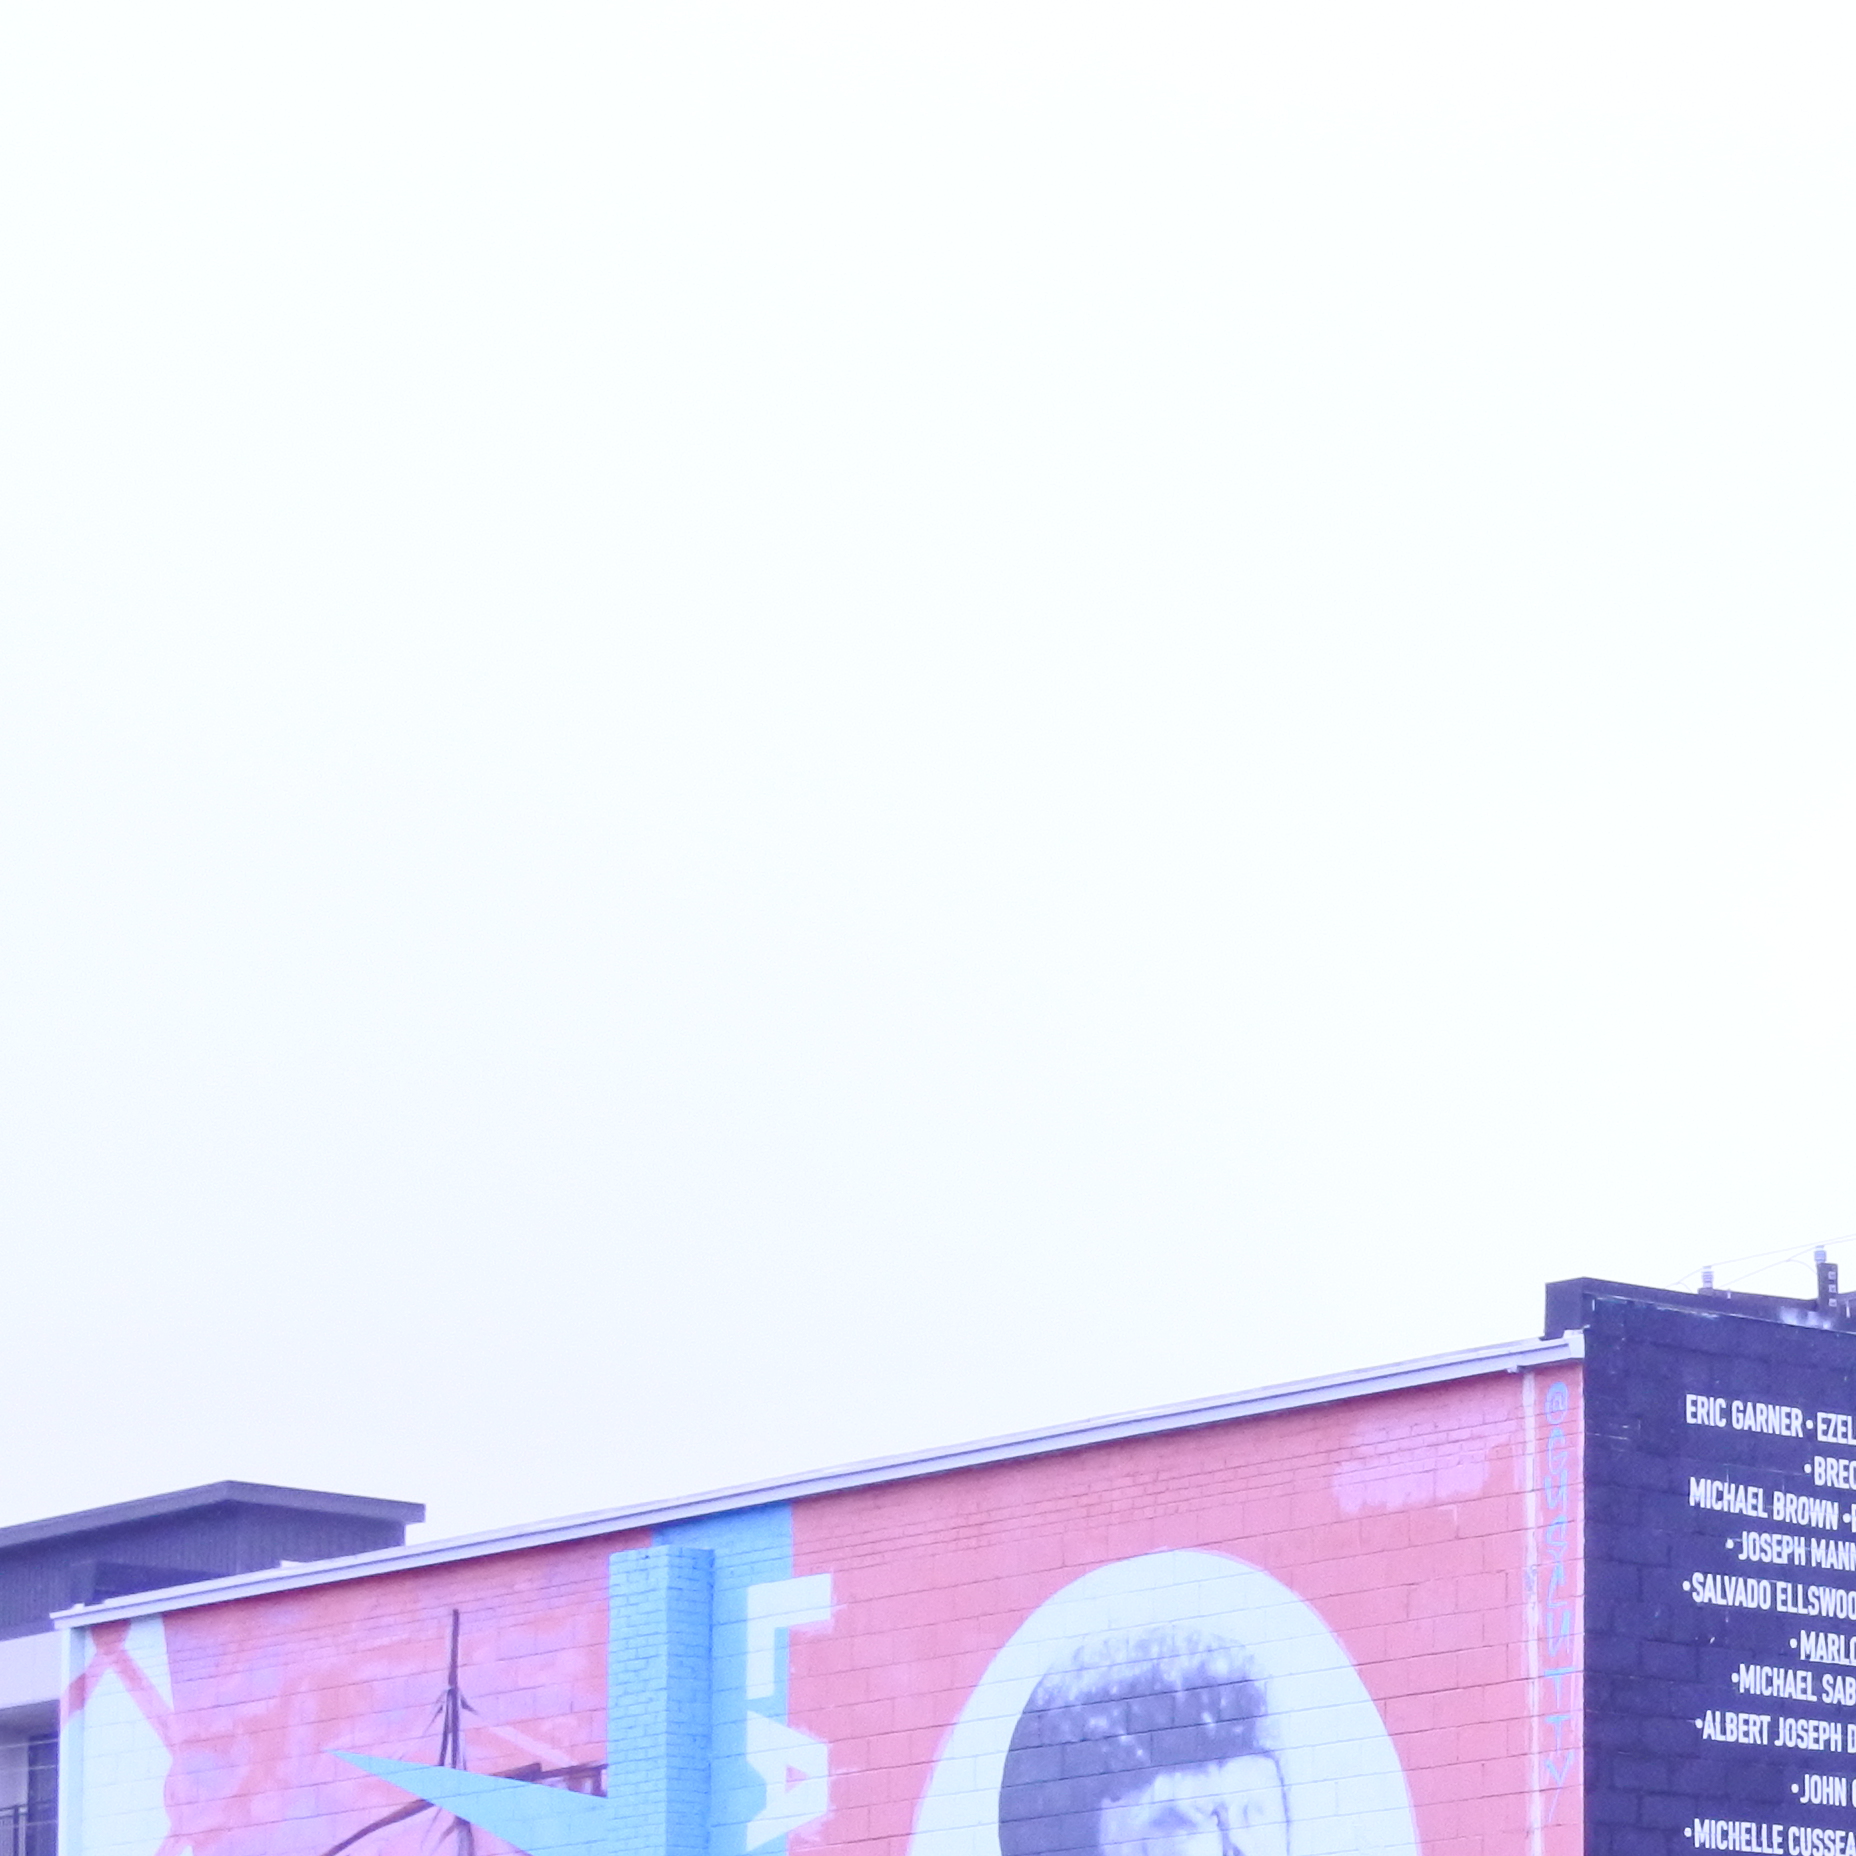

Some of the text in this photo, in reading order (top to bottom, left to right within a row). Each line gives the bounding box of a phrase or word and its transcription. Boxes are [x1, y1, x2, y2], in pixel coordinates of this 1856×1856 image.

[1686, 1394, 1726, 1427] ERIC
[1732, 1400, 1803, 1438] GARNER
[1689, 1477, 1768, 1518] MICHAEL
[1773, 1491, 1839, 1530] BROWN
[1738, 1531, 1806, 1566] JOSEPH
[1692, 1572, 1771, 1610] SALVADO
[1739, 1664, 1817, 1702] MICHAEL
[744, 1573, 836, 1853] LA
[1703, 1710, 1771, 1745] ALBERT
[1774, 1717, 1842, 1752] JOSEPH
[1800, 1774, 1847, 1806] JOHN
[1694, 1818, 1784, 1855] MICHELLE
